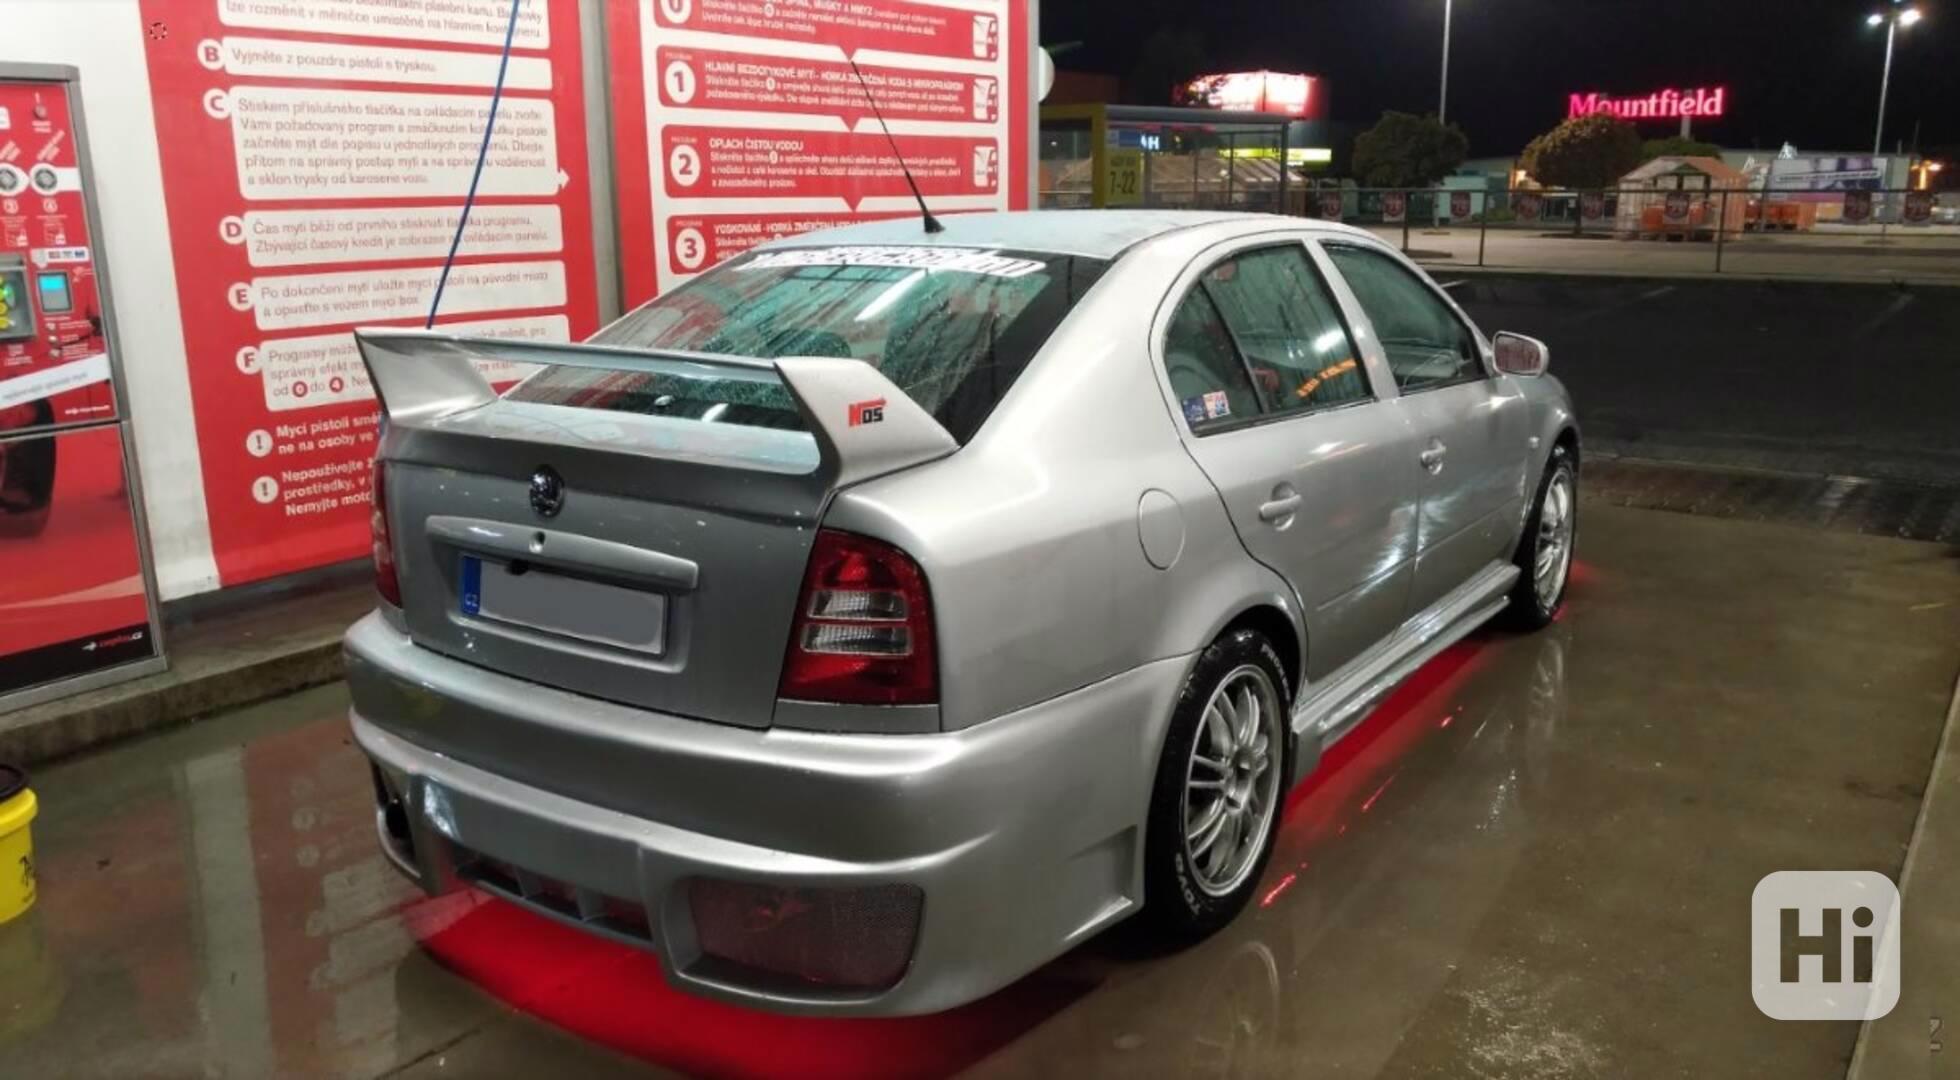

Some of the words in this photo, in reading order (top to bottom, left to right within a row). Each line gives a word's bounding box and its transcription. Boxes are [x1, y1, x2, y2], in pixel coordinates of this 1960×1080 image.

[204, 46, 219, 62] B
[231, 48, 282, 64] Vyjměte
[296, 52, 346, 68] pouzdra
[673, 69, 685, 92] 1
[209, 95, 225, 111] C
[238, 98, 290, 113] Stiskem
[1569, 88, 1724, 119] Mountfield
[240, 118, 272, 131] Vámi
[275, 120, 345, 135] požadovaný
[348, 123, 394, 135] program
[243, 137, 292, 150] začněte
[709, 138, 743, 149] OPLACH
[289, 158, 304, 168] na
[308, 157, 352, 170] správný
[677, 153, 693, 176] 2
[258, 171, 291, 185] sklon
[294, 173, 328, 188] trysky
[225, 222, 242, 237] D
[253, 220, 280, 235] Čas
[310, 221, 335, 233] běží
[337, 220, 353, 231] od
[256, 238, 307, 254] Zbývající
[310, 237, 348, 252] časový
[351, 235, 384, 248] kredit
[683, 238, 698, 258] 3
[235, 288, 249, 304] E
[261, 287, 279, 300] Po
[282, 284, 344, 299] dokončení
[243, 352, 255, 368] F
[268, 347, 327, 363] Programy
[271, 365, 317, 381] správný
[320, 361, 348, 375] efekt
[273, 384, 289, 397] od
[310, 381, 325, 393] do
[278, 443, 295, 455] ne
[298, 440, 315, 451] na
[317, 434, 357, 450] osoby
[359, 431, 374, 442] ve
[282, 459, 364, 482] Nepoužívejte
[285, 496, 339, 516] Nemyjte
[464, 592, 478, 608] CZ
[1175, 852, 1201, 916] TOYO
